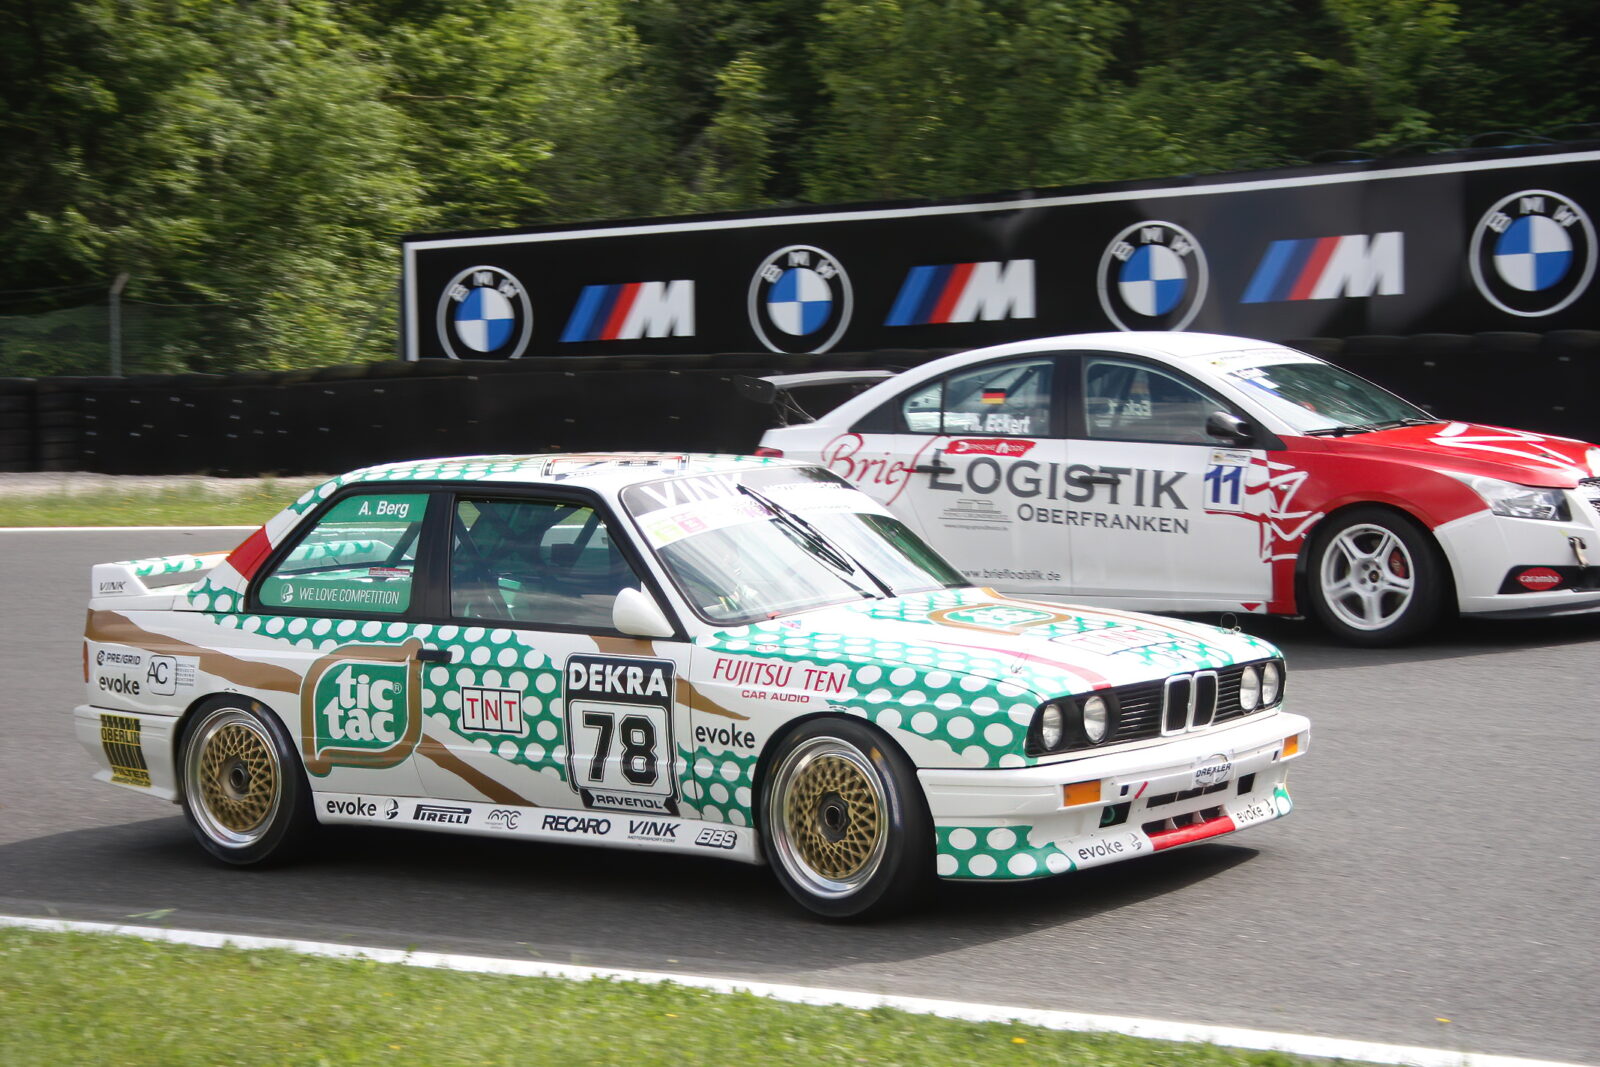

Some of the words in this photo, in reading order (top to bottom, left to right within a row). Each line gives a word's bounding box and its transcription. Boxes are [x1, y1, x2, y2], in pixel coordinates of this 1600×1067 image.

[1308, 231, 1404, 300] M
[947, 259, 1036, 323] M
[615, 280, 695, 340] M
[821, 432, 948, 506] Brief
[928, 448, 1188, 511] LOGISTIK
[1204, 464, 1242, 505] 11
[358, 501, 372, 516] A.
[377, 501, 409, 518] Berg
[1017, 503, 1189, 535] OBERFRANKEN
[961, 569, 1060, 581] ww.brieflogistik.de
[99, 581, 127, 592] VINK
[299, 587, 314, 600] WE
[316, 588, 337, 602] LOVE
[339, 589, 400, 605] COMPETITION
[100, 673, 140, 695] evoke
[568, 662, 669, 697] DEKRA
[713, 658, 793, 687] FUJITSU
[804, 669, 846, 693] TEN
[335, 666, 394, 710] tic
[742, 689, 767, 700] CAR
[770, 693, 810, 704] AUDIO
[323, 697, 395, 742] tac
[466, 698, 517, 722] TNT
[695, 723, 755, 749] evoke
[582, 711, 659, 786] 78
[1195, 762, 1232, 778] DREXLER
[326, 797, 376, 816] evoke
[596, 794, 662, 809] RAVENOL
[413, 804, 472, 824] PIRELLI
[1235, 804, 1264, 823] evoke
[542, 815, 611, 835] RECARO
[628, 820, 681, 838] VINK
[695, 828, 738, 849] BBS
[1078, 838, 1124, 860] evoke
